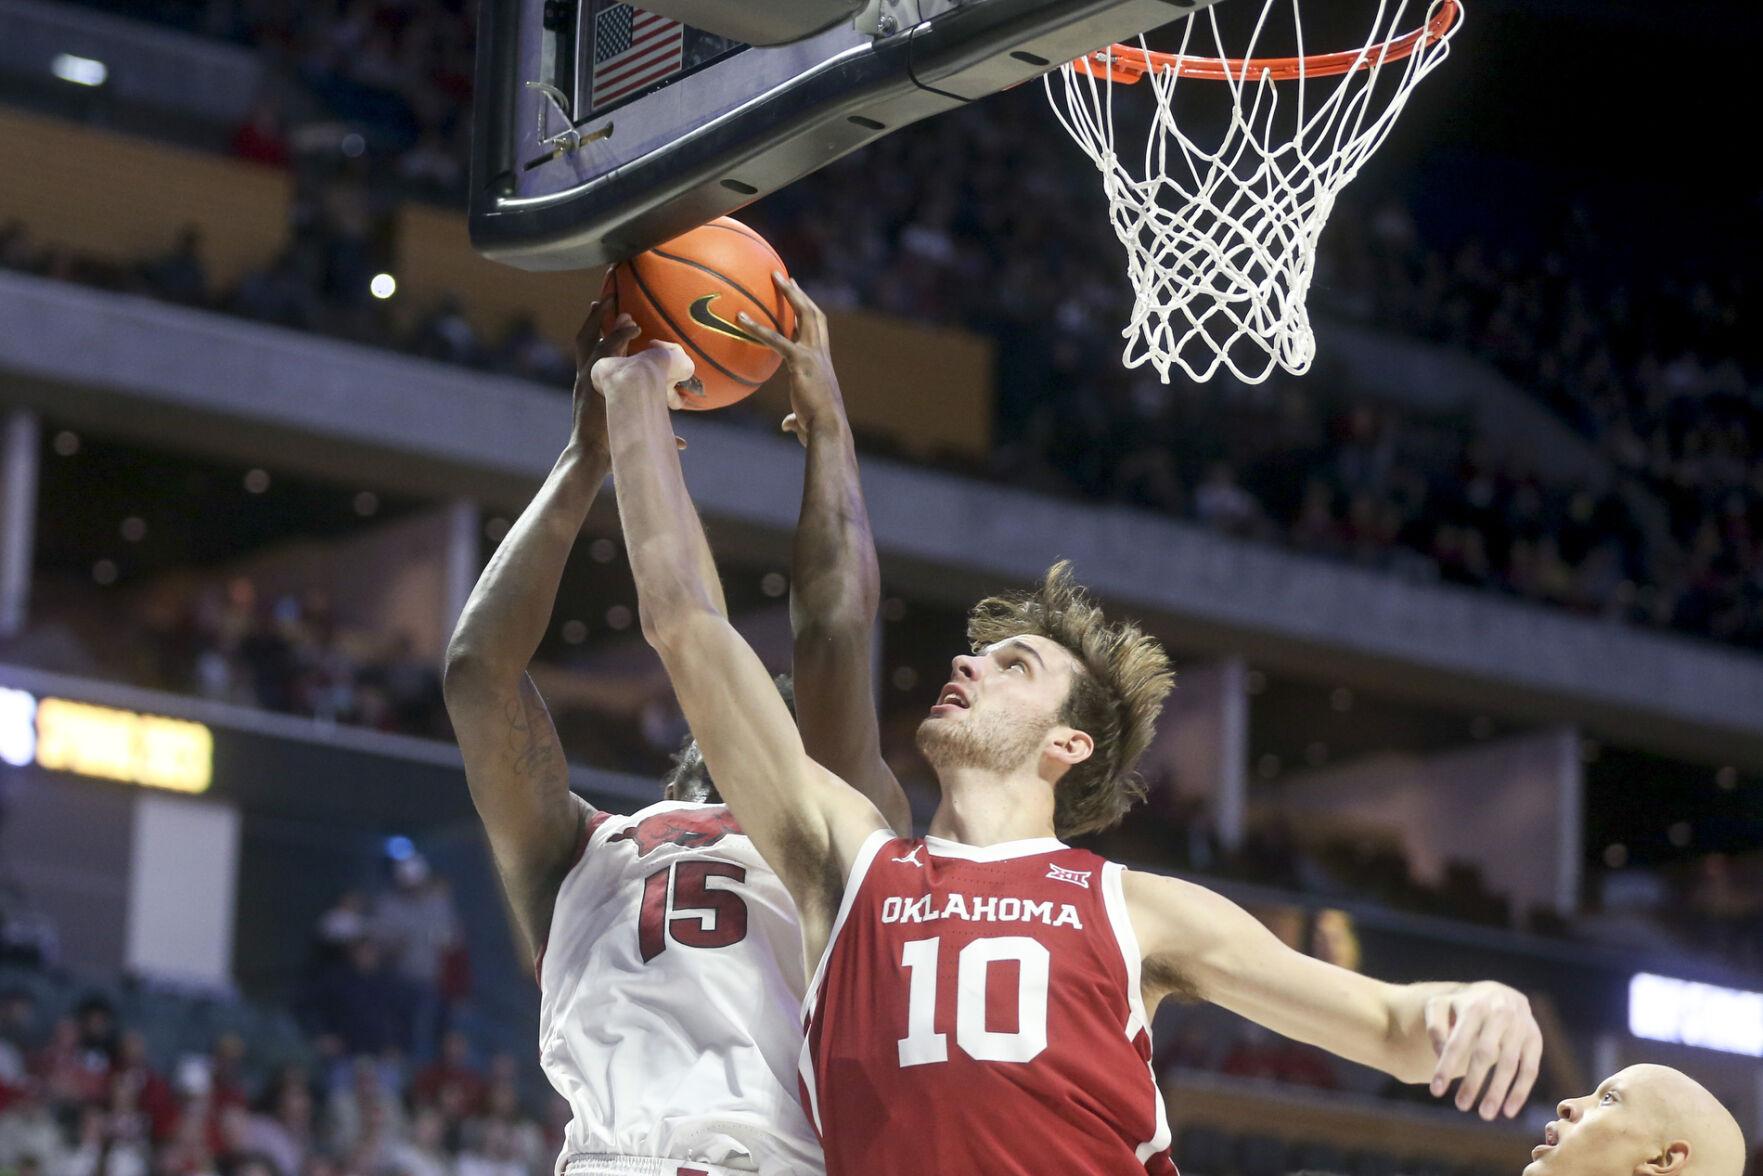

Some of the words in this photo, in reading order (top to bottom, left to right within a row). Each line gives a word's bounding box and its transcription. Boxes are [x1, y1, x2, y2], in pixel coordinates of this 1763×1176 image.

[638, 860, 748, 964] 15
[881, 893, 1083, 930] OKLAHOMA
[898, 936, 1050, 1068] 10
